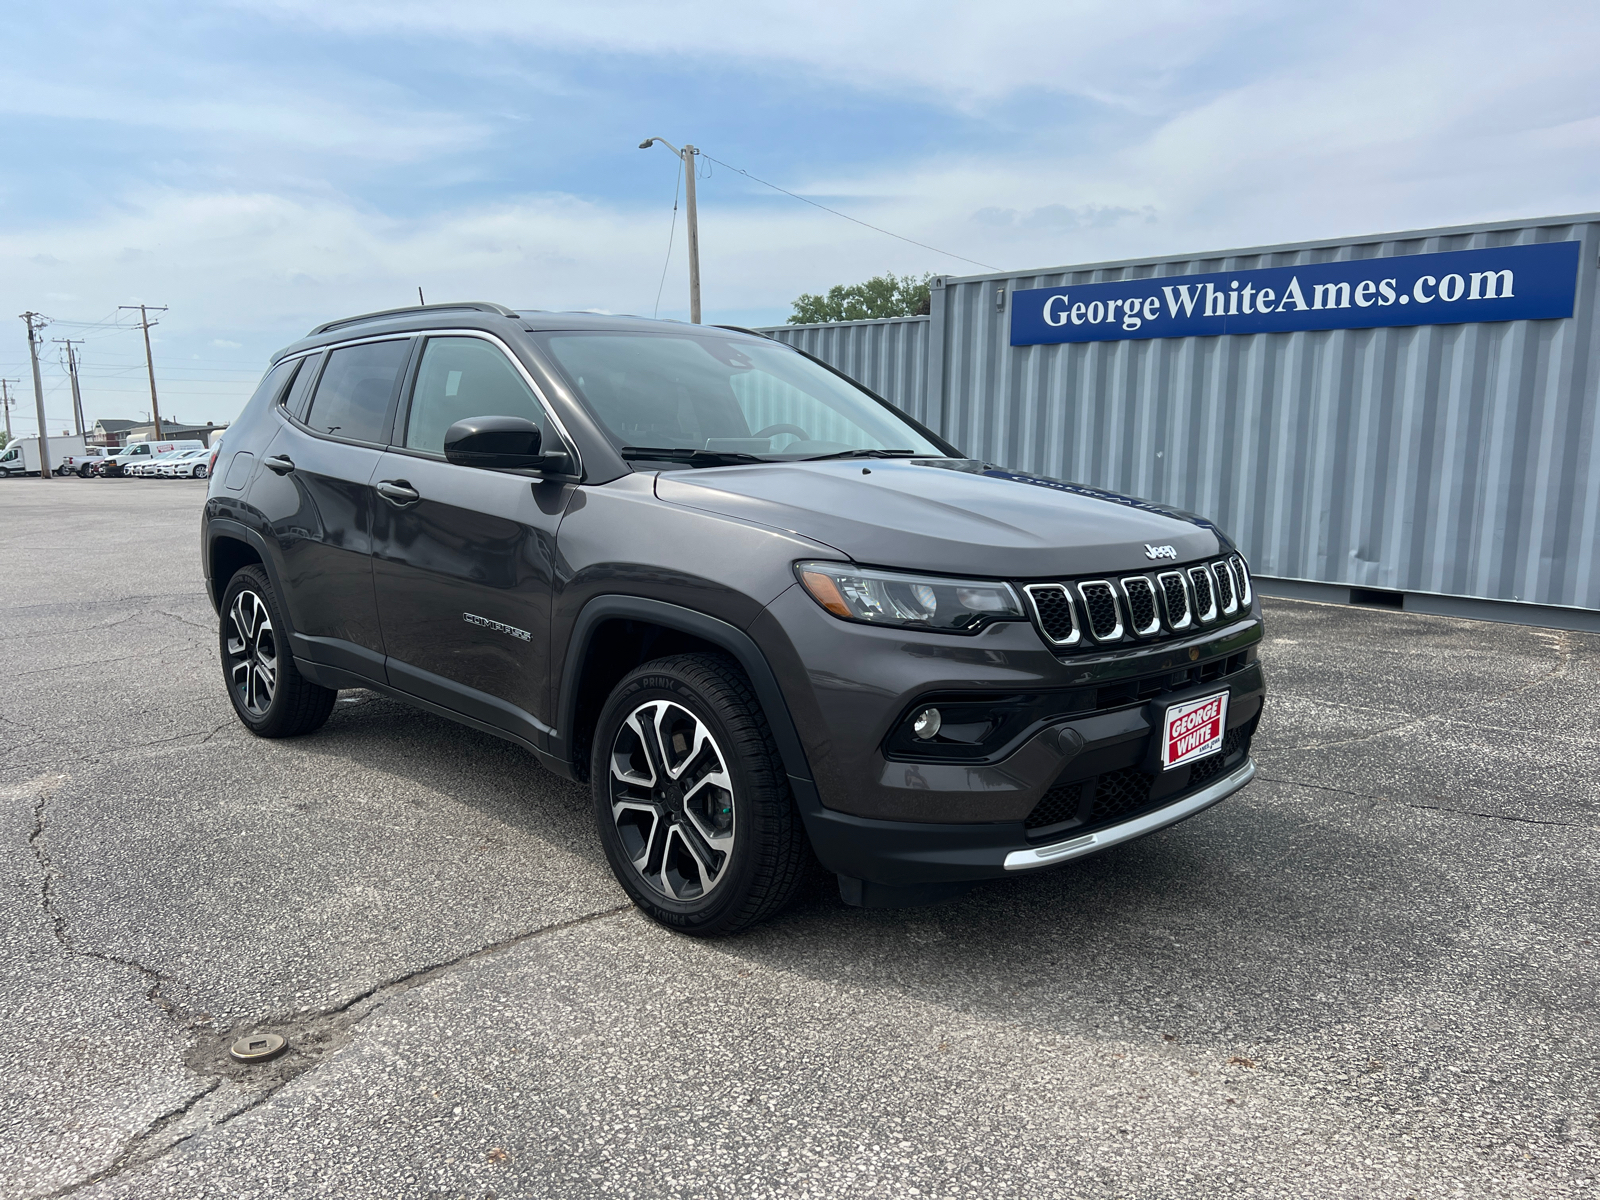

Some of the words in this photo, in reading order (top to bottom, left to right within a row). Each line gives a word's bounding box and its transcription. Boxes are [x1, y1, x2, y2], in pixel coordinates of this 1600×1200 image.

[1043, 267, 1516, 331] GeorgeWhiteAmes.com
[1144, 544, 1177, 560] Jeep
[463, 612, 533, 642] COMPASS
[642, 677, 675, 691] PRINX
[1172, 701, 1219, 738] GEORGE
[1177, 723, 1212, 756] WHITE
[653, 906, 686, 926] PRINX
